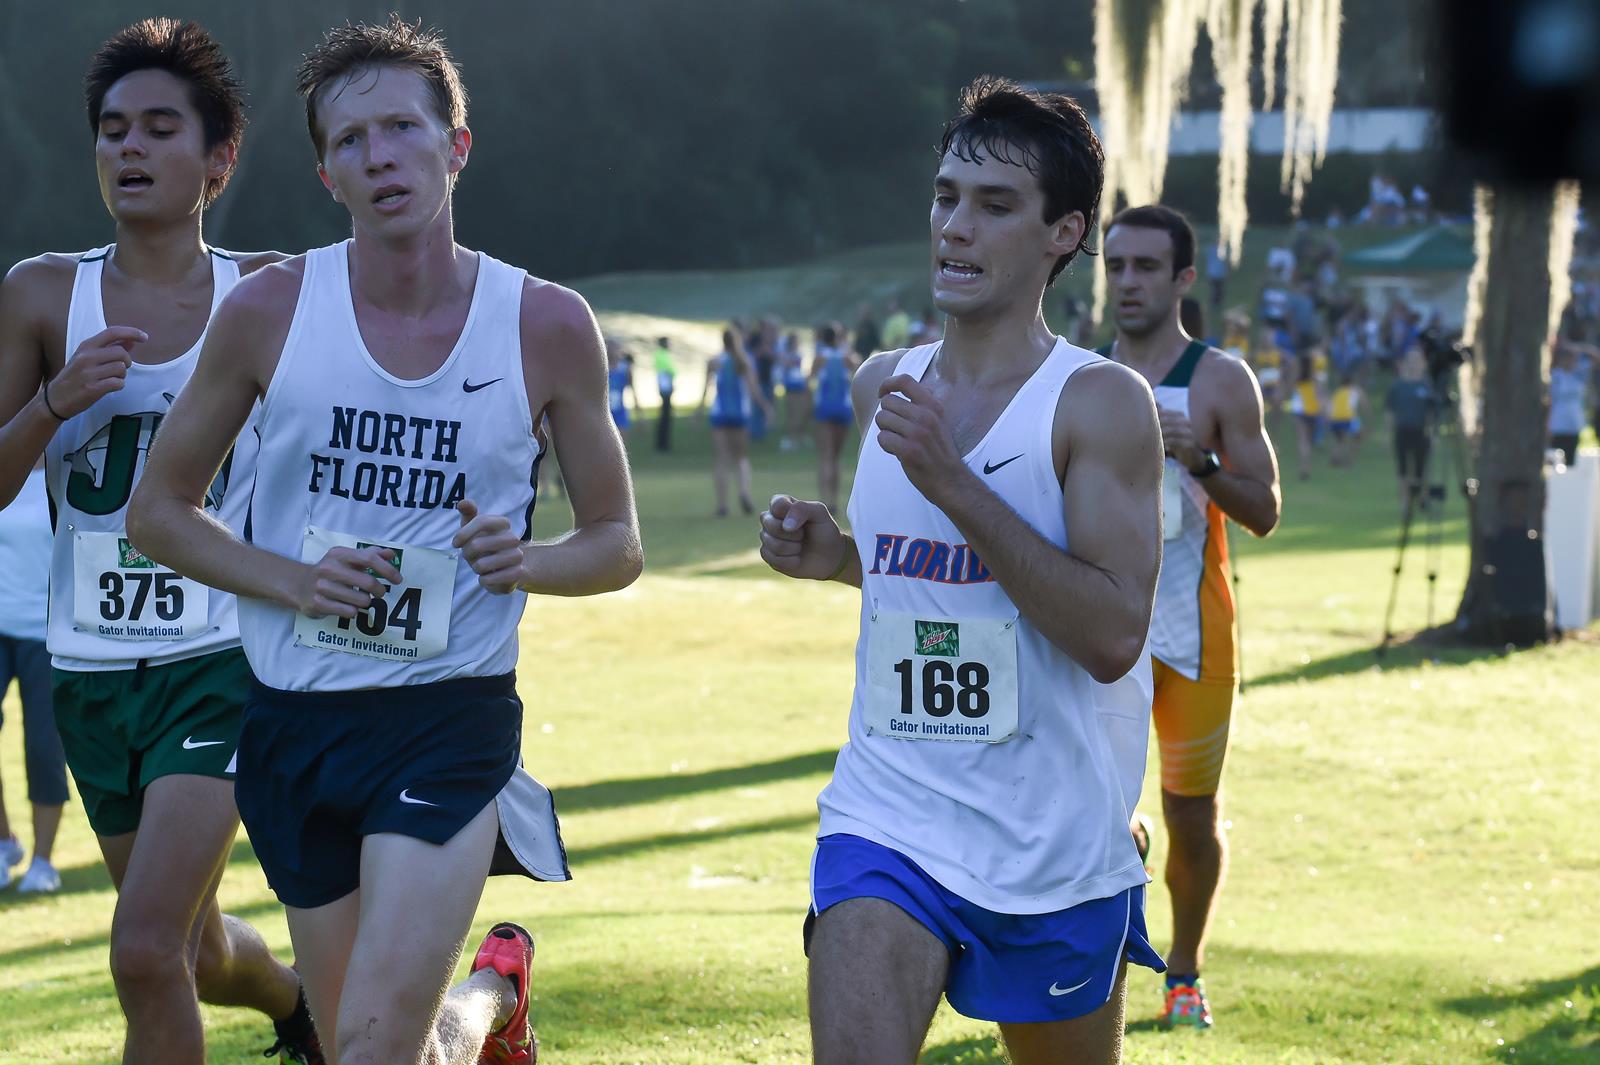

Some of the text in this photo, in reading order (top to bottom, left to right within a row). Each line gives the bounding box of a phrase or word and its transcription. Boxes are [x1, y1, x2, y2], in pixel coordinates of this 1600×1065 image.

[328, 406, 461, 463] NORTH
[308, 454, 467, 510] FLORIDA
[868, 533, 995, 584] FLORID
[99, 571, 184, 621] 375
[338, 584, 422, 641] 54
[98, 624, 184, 637] Gator Invitational
[317, 630, 349, 647] Gator
[351, 637, 419, 658] Invitational
[894, 658, 990, 718] 168
[890, 718, 990, 736] Gator Invitational
